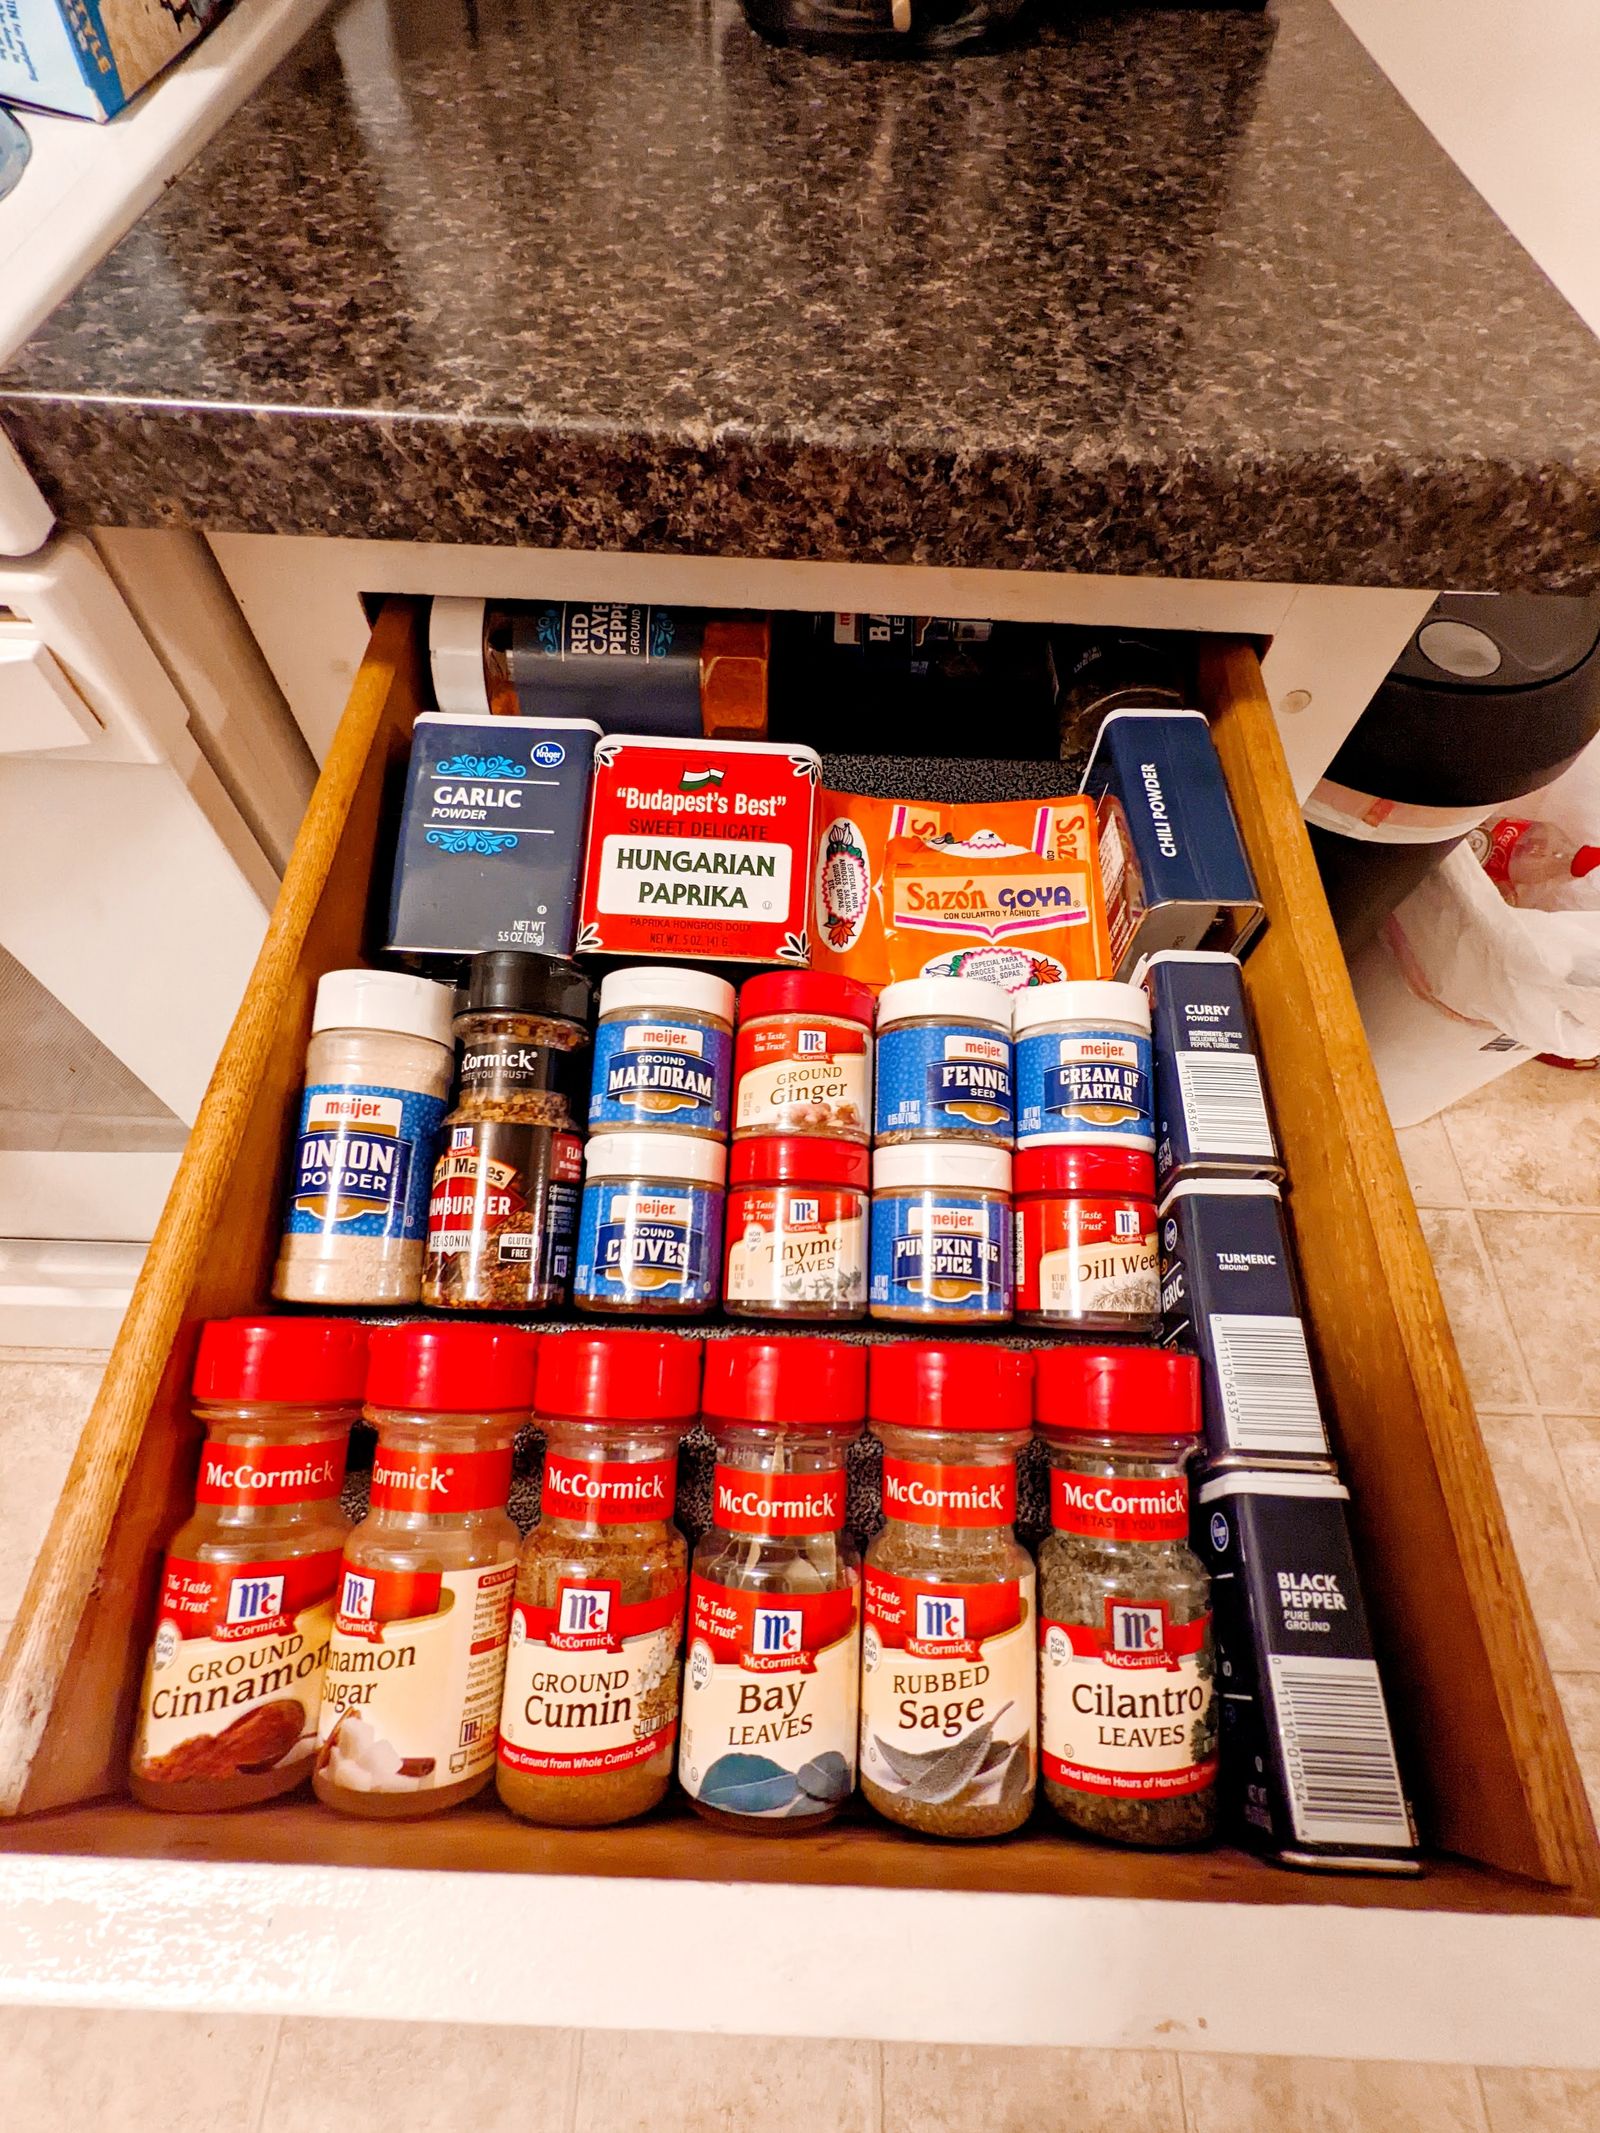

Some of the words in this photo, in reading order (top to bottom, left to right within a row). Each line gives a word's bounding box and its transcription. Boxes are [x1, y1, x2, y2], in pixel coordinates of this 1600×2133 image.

[571, 613, 589, 654] RED
[590, 604, 609, 655] CAYE
[610, 602, 628, 655] PEPPE
[630, 608, 641, 655] GROUND
[536, 745, 561, 763] Kroger
[433, 786, 523, 808] GARLIC
[1141, 762, 1168, 820] POWDER
[431, 807, 487, 820] POWDER
[628, 818, 685, 837] SWEET
[690, 825, 769, 841] DELICATE
[1055, 815, 1086, 861] Saz
[1155, 822, 1177, 858] CHILI
[615, 848, 777, 878] HUNGARIAN
[638, 880, 749, 909] PAPRIKA
[906, 879, 989, 912] Sazón
[998, 886, 1072, 911] GOYA
[630, 917, 671, 928] PAPRIKA
[673, 920, 723, 932] HONGROIS
[944, 912, 960, 920] CON
[962, 910, 1001, 919] CULANTRO
[1010, 909, 1041, 918] ACHIOTE
[513, 920, 530, 932] NET
[531, 921, 546, 932] WT
[497, 931, 510, 942] 5.5
[511, 931, 524, 942] OZ
[524, 931, 545, 947] (155g)
[650, 933, 665, 945] NET
[971, 960, 1000, 969] ESPECIAL
[1002, 956, 1018, 966] PARA
[1185, 1004, 1230, 1016] CURRY
[643, 1029, 687, 1046] meijer
[754, 1044, 765, 1052] You
[766, 1042, 786, 1051] Trust
[755, 1032, 766, 1042] The
[767, 1031, 787, 1041] Taste
[637, 1055, 686, 1066] GROUND
[965, 1041, 1001, 1058] meijer
[1081, 1042, 1124, 1058] meijer
[461, 1049, 535, 1073] Cormick
[608, 1065, 712, 1098] MARJORAM
[776, 1066, 843, 1086] GROUND
[941, 1065, 1011, 1096] FENNEL
[1060, 1067, 1119, 1085] CREAM
[1124, 1070, 1140, 1088] OF
[770, 1083, 848, 1105] Ginger
[970, 1088, 996, 1099] SEED
[1069, 1083, 1133, 1102] TARTAR
[325, 1097, 381, 1119] meijer
[301, 1138, 396, 1174] ONION
[455, 1157, 505, 1182] Maes
[1080, 1210, 1102, 1219] Taste
[1080, 1221, 1103, 1231] Trust
[511, 1248, 528, 1258] FREE
[606, 1239, 689, 1265] COVES
[1217, 1253, 1277, 1266] TURMERIC
[785, 1256, 835, 1278] EAVES
[930, 1256, 973, 1275] SPICE
[1077, 1257, 1116, 1283] Dill
[1225, 1382, 1241, 1422] 68337
[206, 1461, 334, 1489] McCormick
[373, 1459, 448, 1493] Cormick
[548, 1466, 664, 1499] McCormick
[719, 1486, 835, 1518] McCormick
[886, 1475, 1003, 1510] McCormick
[1062, 1482, 1185, 1514] McCormick
[167, 1573, 180, 1591] The
[182, 1578, 212, 1595] Taste
[865, 1580, 876, 1596] The
[876, 1585, 902, 1606] Taste
[1277, 1572, 1339, 1593] BLACK
[163, 1592, 177, 1610] You
[178, 1596, 211, 1614] Trust
[697, 1595, 709, 1612] The
[710, 1601, 738, 1621] Taste
[865, 1598, 876, 1614] You
[876, 1604, 901, 1625] Trust
[1281, 1590, 1347, 1611] PEPPER
[695, 1612, 708, 1630] You
[709, 1619, 737, 1641] Trust
[1283, 1611, 1310, 1621] PURE
[1285, 1620, 1330, 1632] GROUND
[214, 1618, 288, 1640] McCormick
[550, 1632, 615, 1648] McCormick
[864, 1637, 877, 1651] NON
[908, 1639, 973, 1655] McCormick
[1051, 1637, 1065, 1648] NON
[1051, 1646, 1066, 1658] GMO
[187, 1634, 304, 1685] GROUND
[694, 1653, 708, 1665] NON
[743, 1653, 809, 1670] McCormick
[1104, 1651, 1173, 1667] McCormick
[152, 1641, 330, 1720] Cinnamon
[532, 1669, 630, 1694] GROUND
[692, 1663, 708, 1678] GMO
[893, 1665, 990, 1694] RUBBED
[525, 1692, 632, 1729] Cumin
[737, 1680, 806, 1719] Bay
[1072, 1682, 1204, 1720] Cilantro
[898, 1697, 986, 1738] Sage
[728, 1713, 813, 1746] LEAVES
[1098, 1724, 1186, 1748] LEAVES
[520, 1753, 548, 1769] Ground
[549, 1757, 571, 1769] from
[573, 1755, 602, 1769] Whole
[604, 1748, 634, 1765] Cumin
[634, 1740, 657, 1757] Seeds
[1060, 1763, 1081, 1779] Dried
[1082, 1770, 1112, 1786] Within
[1113, 1776, 1142, 1788] Hours
[1143, 1777, 1153, 1788] of
[1155, 1773, 1189, 1788] Harvest
